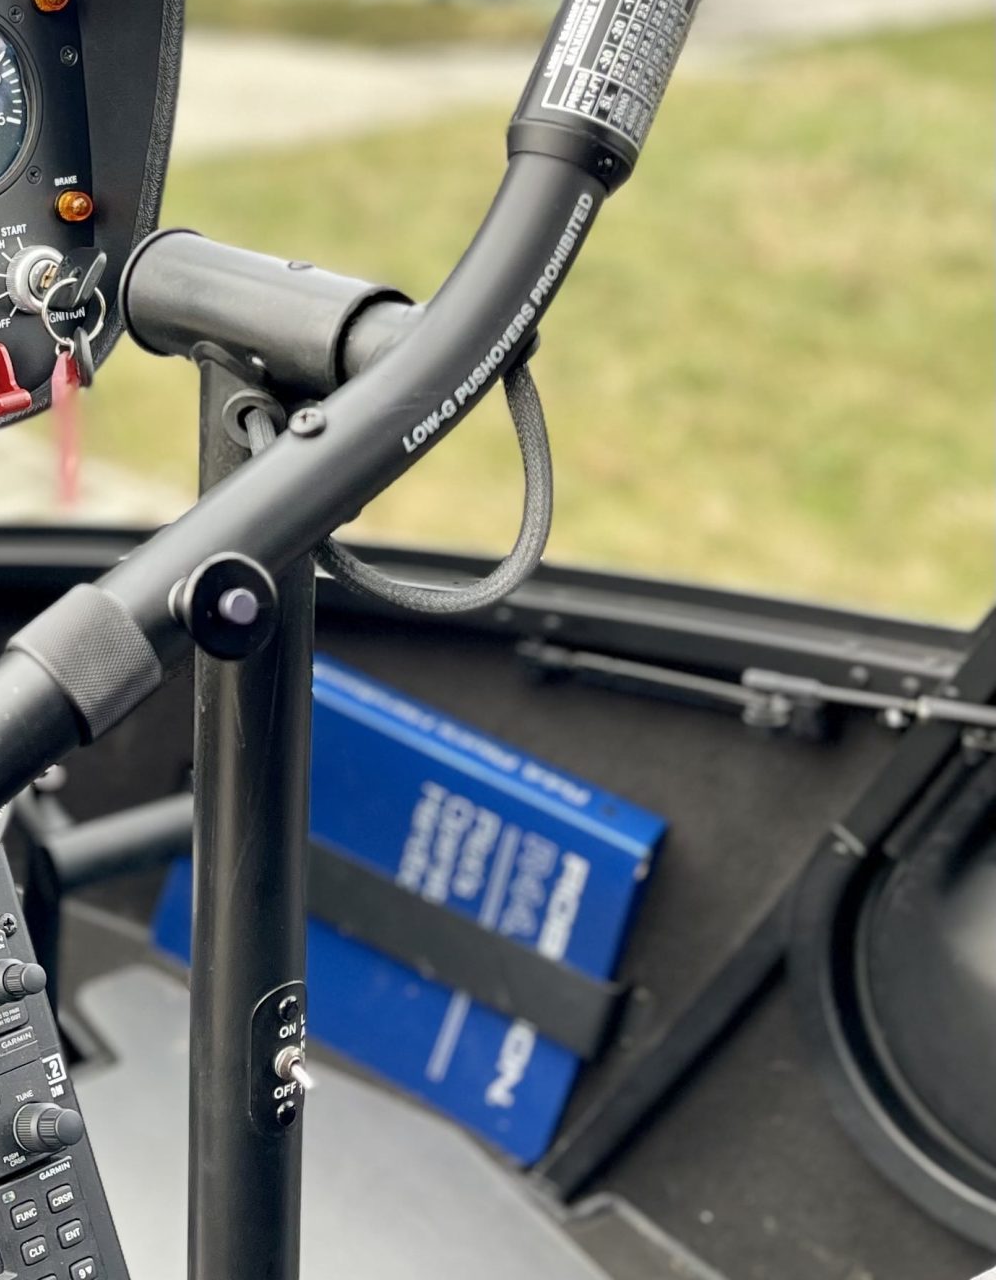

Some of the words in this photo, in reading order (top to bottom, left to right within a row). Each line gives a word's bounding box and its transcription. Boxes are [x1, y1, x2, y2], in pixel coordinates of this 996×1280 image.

[55, 176, 78, 186] BRAKE
[1, 224, 27, 237] START
[402, 399, 458, 454] LOW-G
[454, 303, 536, 406] PUSHOVERS
[529, 192, 593, 306] PROHIBITED
[279, 1022, 296, 1039] ON
[1, 1032, 32, 1049] GARMIN
[16, 1090, 34, 1102] TUNE
[274, 1081, 296, 1099] OFF
[39, 1161, 70, 1181] GARMIN
[16, 1208, 37, 1223] FUNC
[52, 1191, 74, 1207] CRSR
[29, 1245, 45, 1258] CLR
[65, 1228, 80, 1241] ENT
